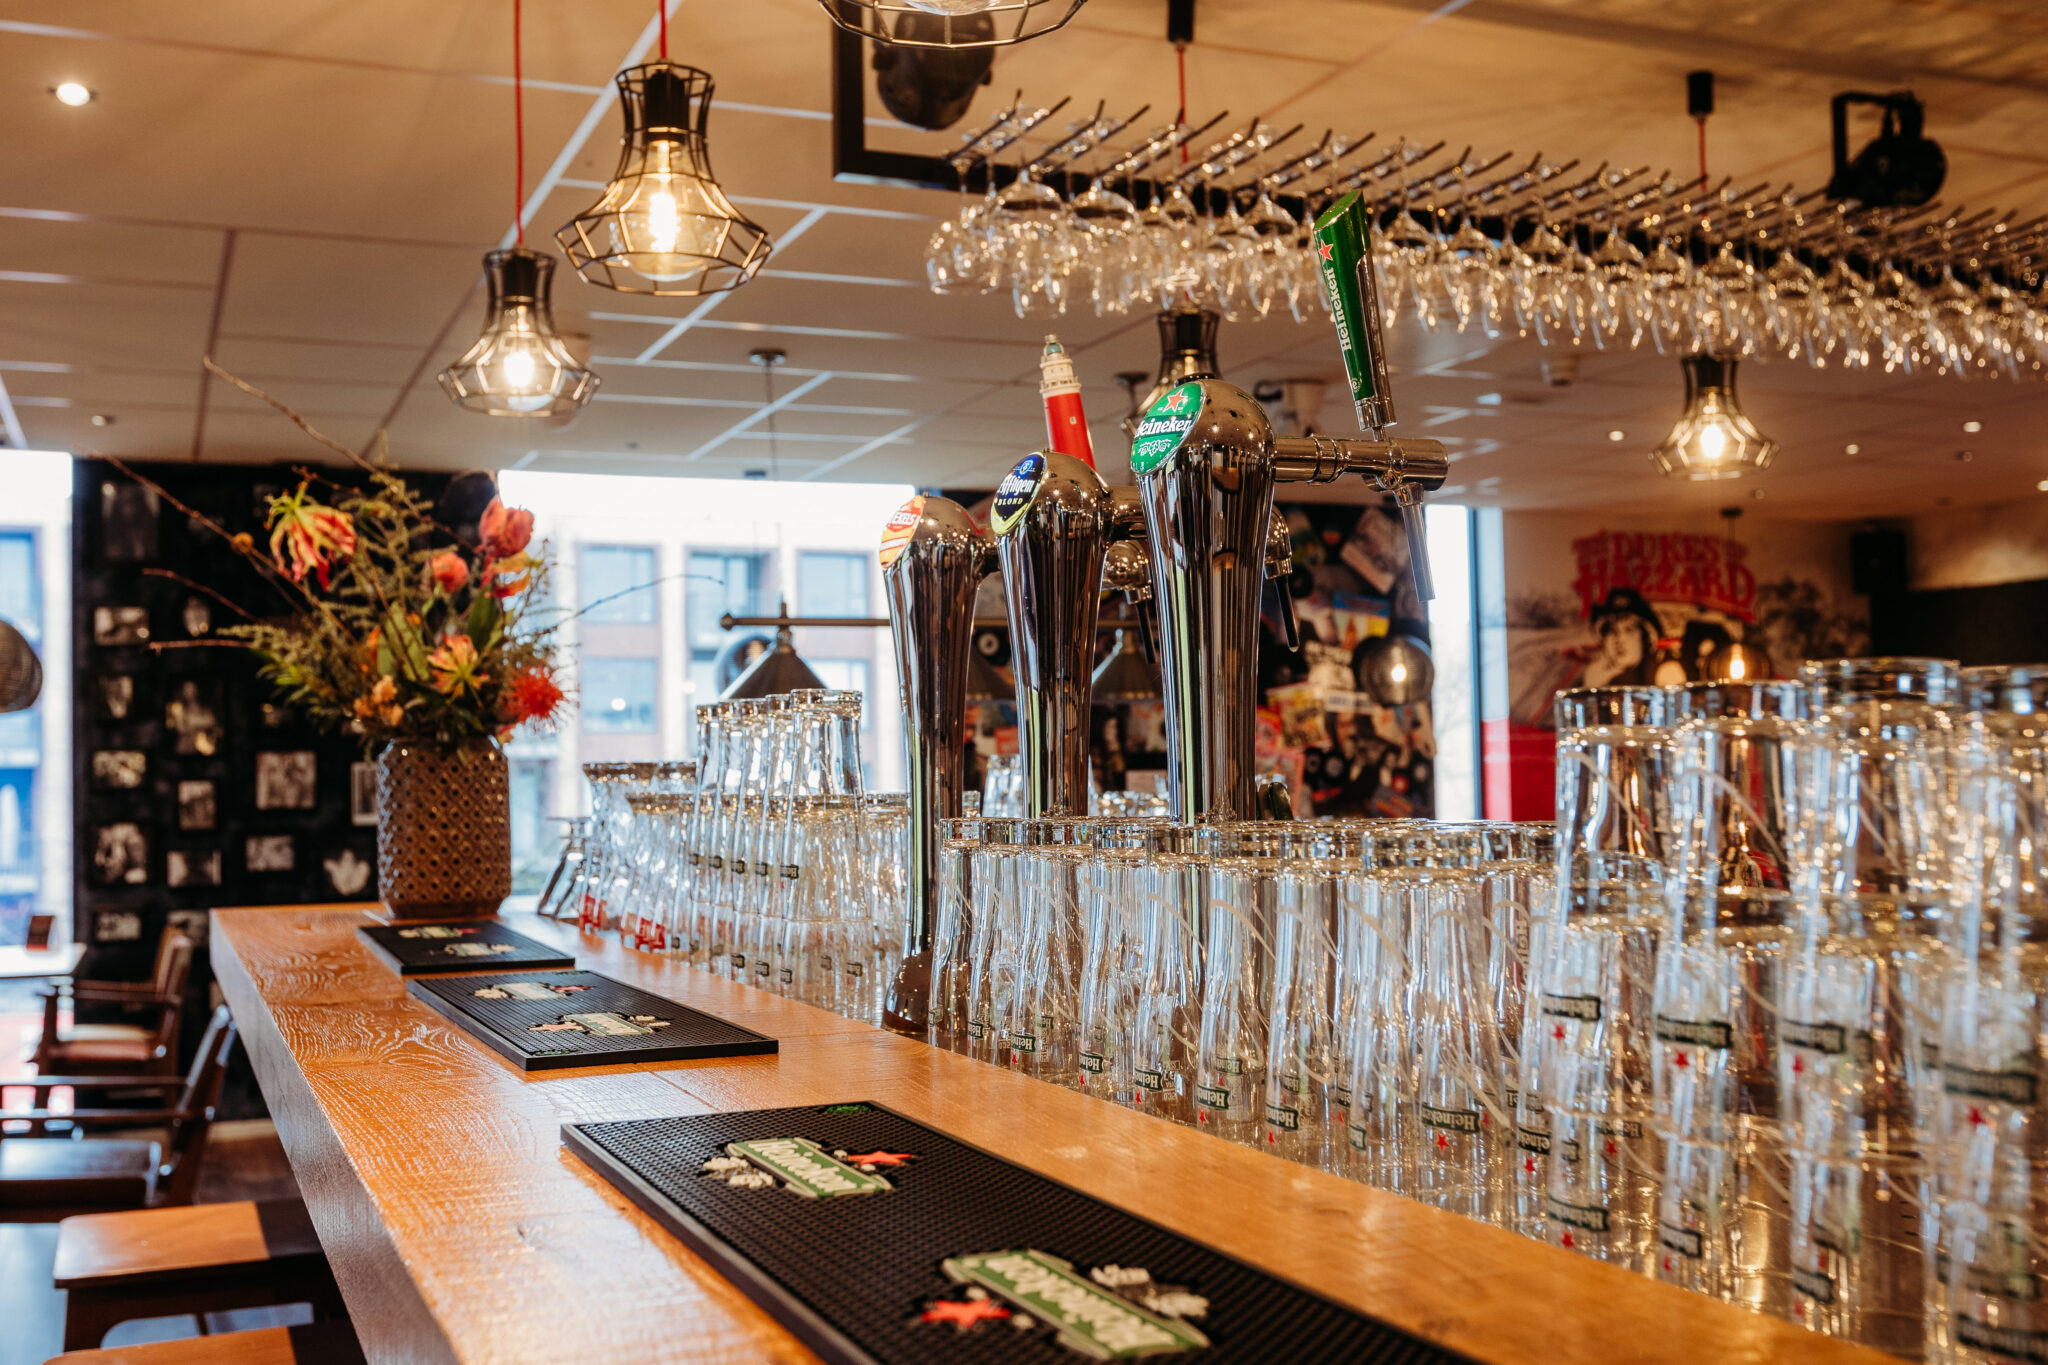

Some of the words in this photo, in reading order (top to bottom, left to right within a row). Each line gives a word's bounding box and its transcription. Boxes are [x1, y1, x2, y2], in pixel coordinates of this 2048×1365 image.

[1325, 267, 1352, 351] Heineken
[997, 497, 1023, 506] BLOND
[1613, 531, 1720, 563] DUKES
